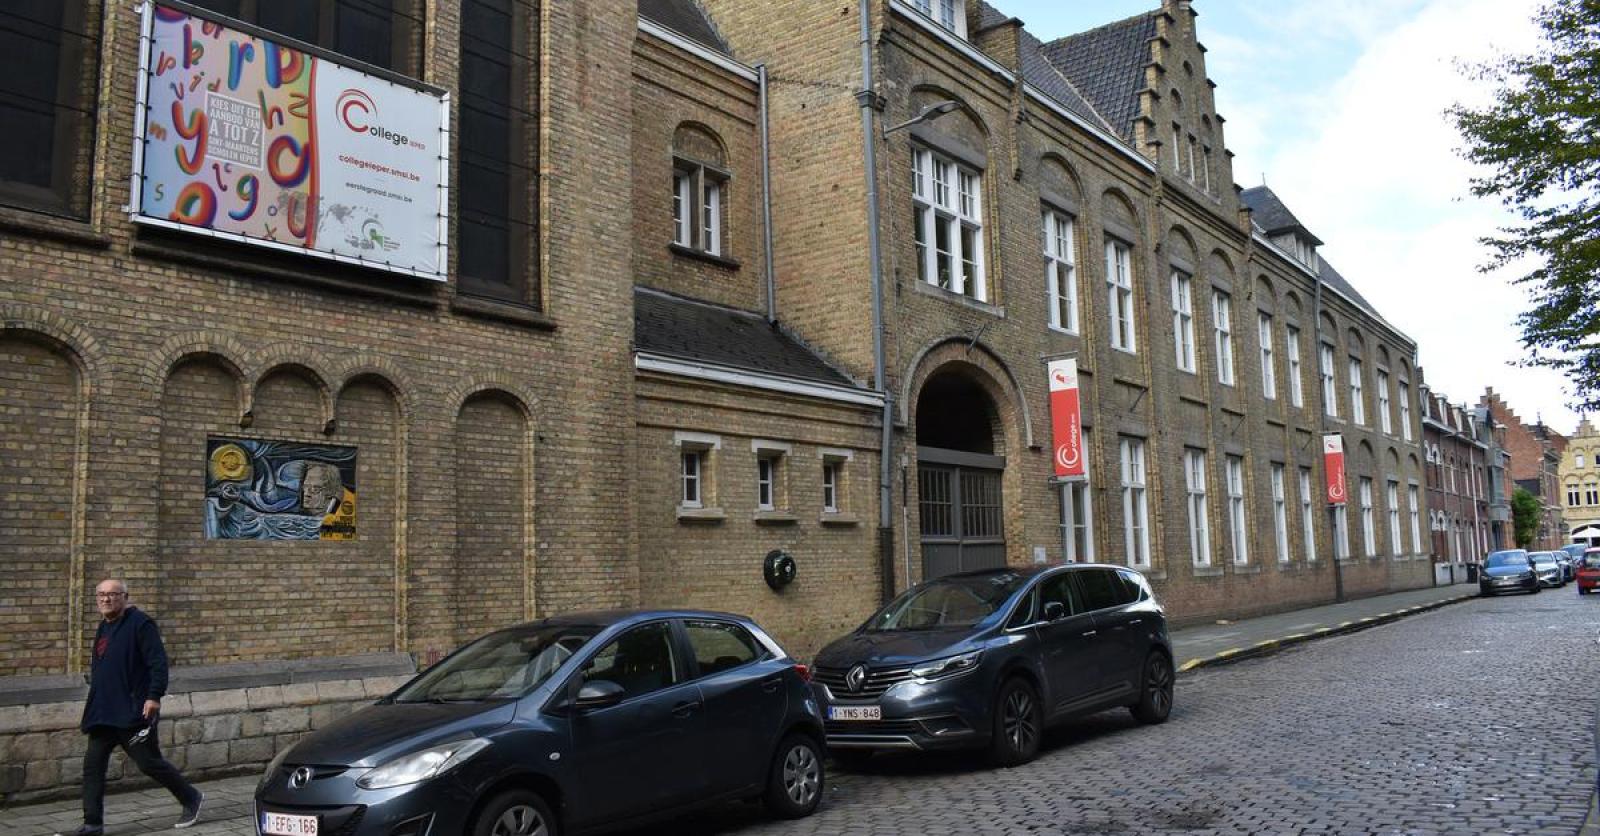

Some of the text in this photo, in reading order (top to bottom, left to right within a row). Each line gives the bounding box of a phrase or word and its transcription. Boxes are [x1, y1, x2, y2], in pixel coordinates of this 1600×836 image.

[210, 97, 260, 119] KIES UIT EEN
[210, 109, 261, 129] AANBOD VAN
[209, 119, 261, 146] A TOT Z
[340, 96, 409, 146] College
